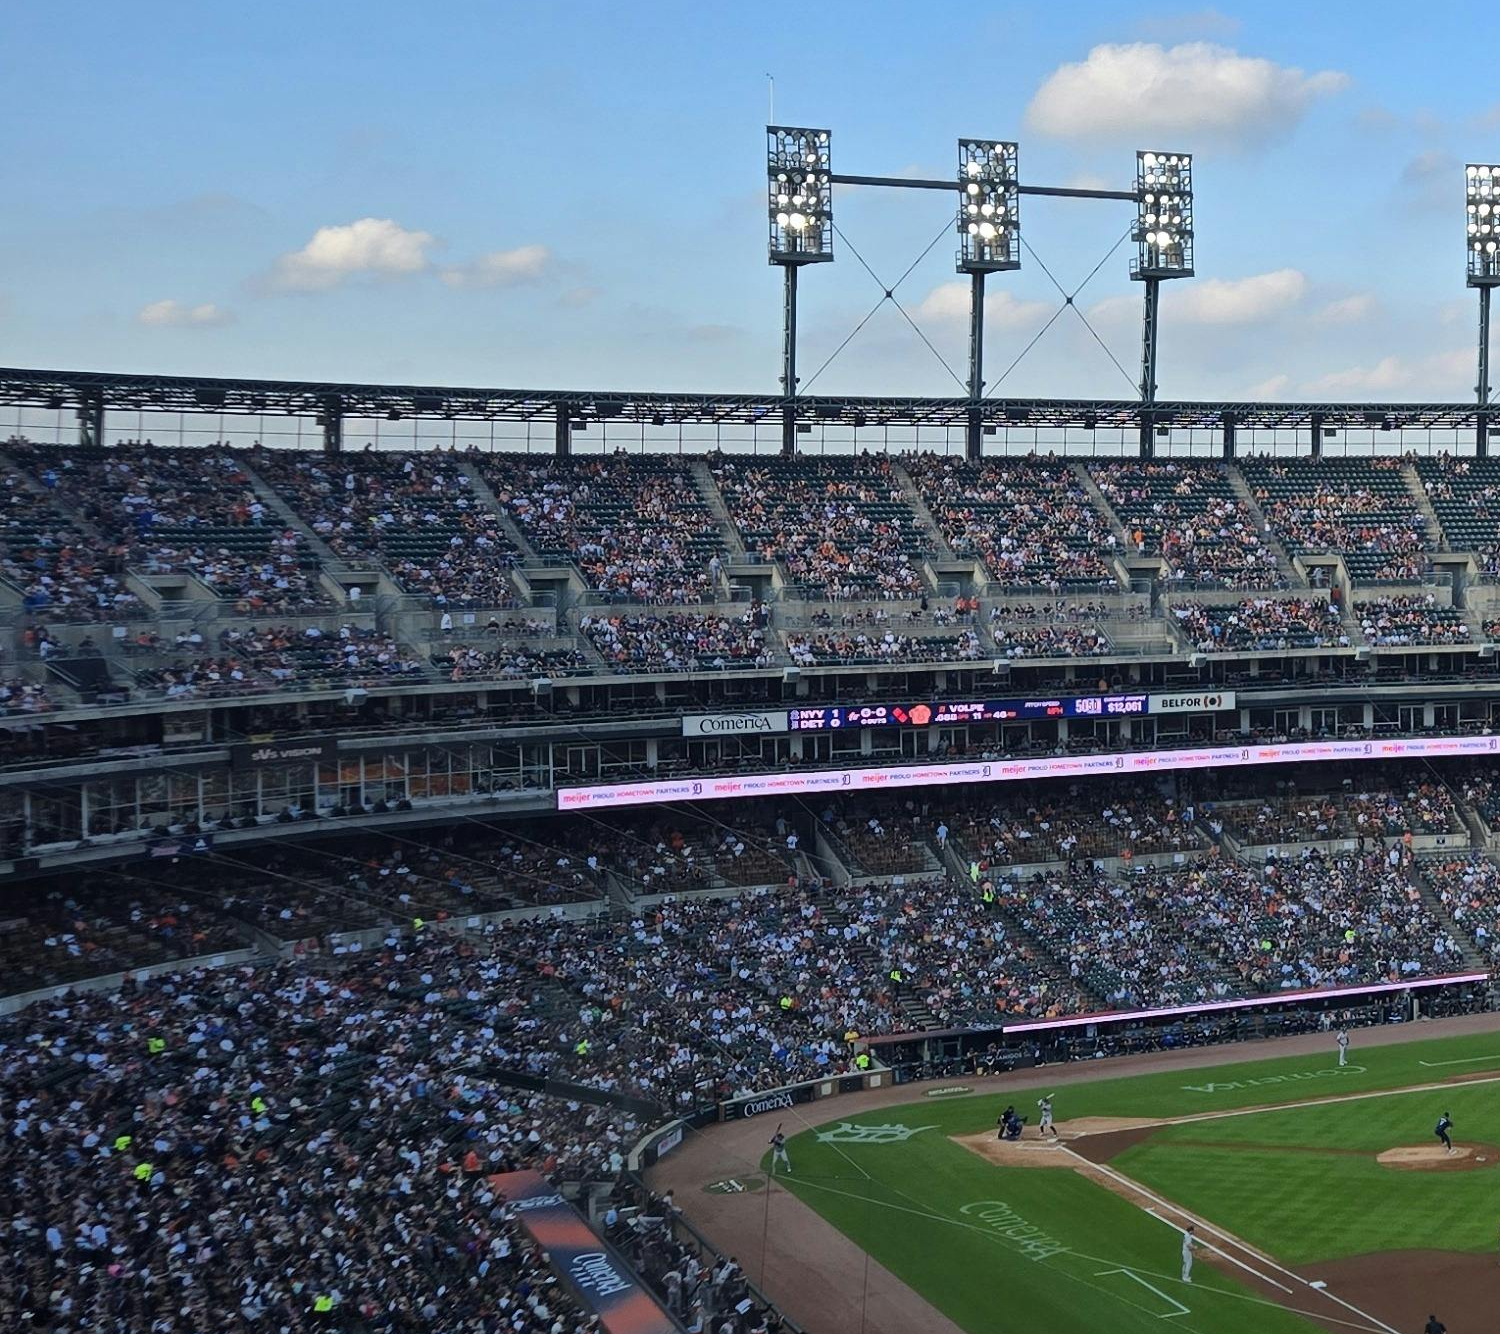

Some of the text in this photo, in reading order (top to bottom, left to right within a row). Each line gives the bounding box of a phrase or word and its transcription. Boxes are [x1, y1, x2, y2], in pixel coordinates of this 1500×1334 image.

[949, 704, 984, 713] VOLPE
[1161, 698, 1201, 708] BELFOR
[800, 710, 824, 719] NYY
[800, 719, 825, 729] DET
[1002, 765, 1026, 775] meijer
[1084, 761, 1113, 769] PARTNERS
[862, 774, 888, 784] meijer
[912, 771, 948, 779] HOMETOWN
[950, 769, 980, 777] PARTNERS
[714, 777, 840, 793] meijer PROUD HOMETOWN PARTNERS
[563, 793, 590, 804] meijer
[616, 790, 655, 798] HOMETOWN
[656, 787, 690, 795] PARTNERS
